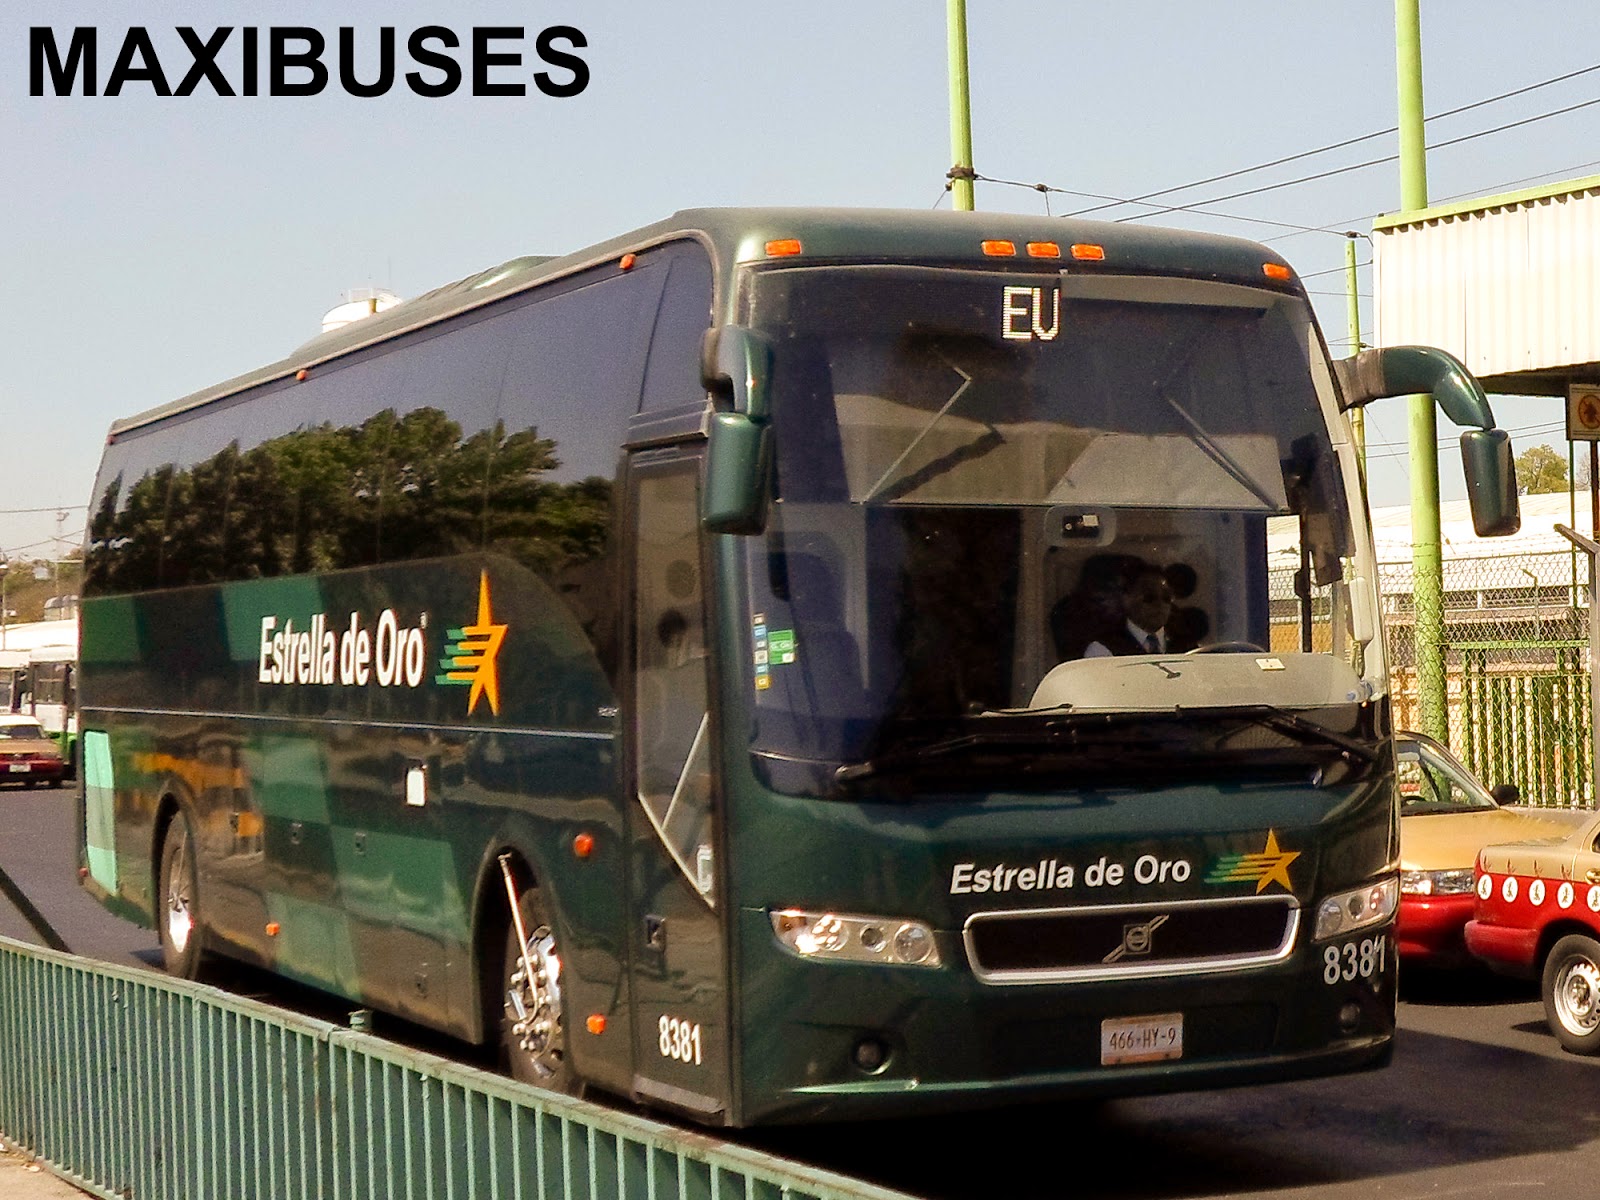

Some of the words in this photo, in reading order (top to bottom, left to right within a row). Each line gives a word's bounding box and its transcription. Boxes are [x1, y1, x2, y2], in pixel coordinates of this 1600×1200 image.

[259, 613, 337, 686] Estrella
[340, 610, 371, 686] de
[950, 859, 1075, 895] Estrella
[1084, 857, 1125, 888] de
[1133, 854, 1192, 886] Oro
[1323, 934, 1386, 985] 8381
[658, 1014, 703, 1066] 8381
[1109, 1027, 1177, 1051] 466-HY-9
